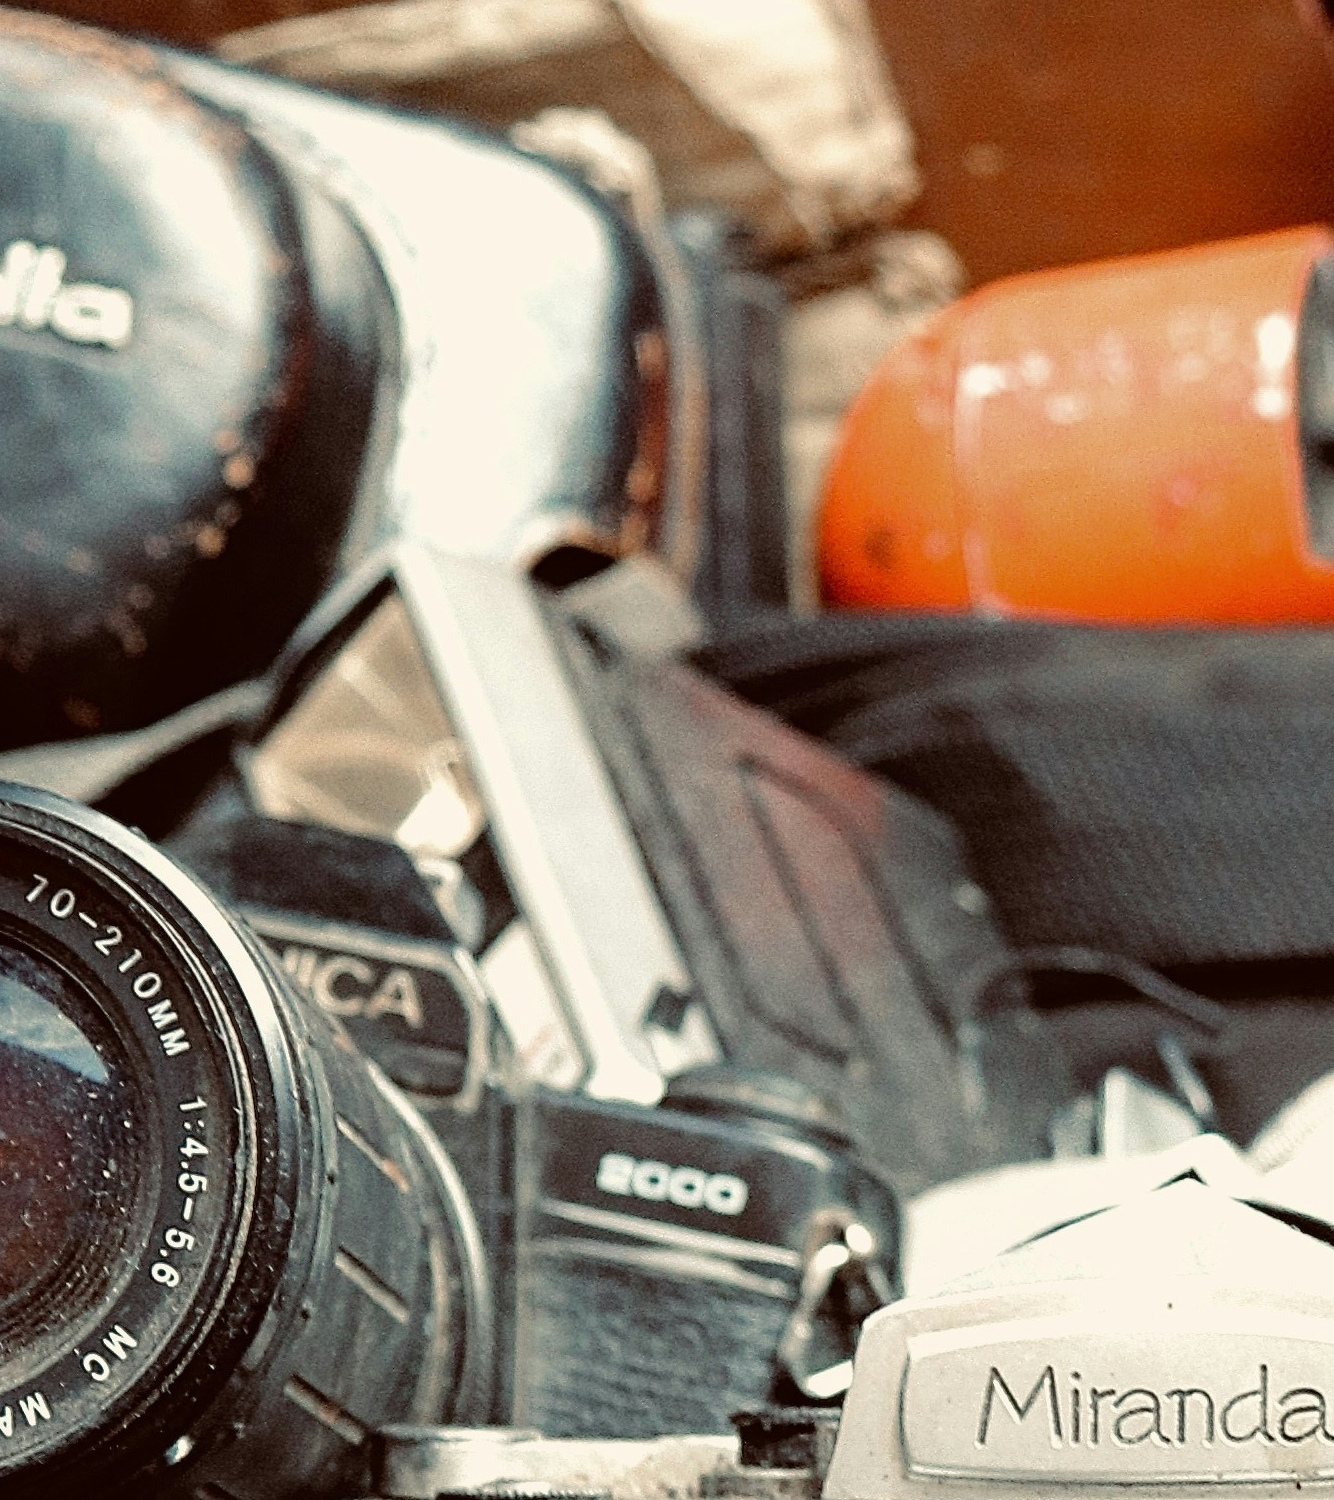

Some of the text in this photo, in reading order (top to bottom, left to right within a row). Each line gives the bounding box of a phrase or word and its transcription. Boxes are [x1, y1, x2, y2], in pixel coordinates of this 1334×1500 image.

[24, 874, 192, 1058] 70-210MM
[150, 1096, 209, 1289] 1:4.5-5.6
[82, 1323, 139, 1384] MC
